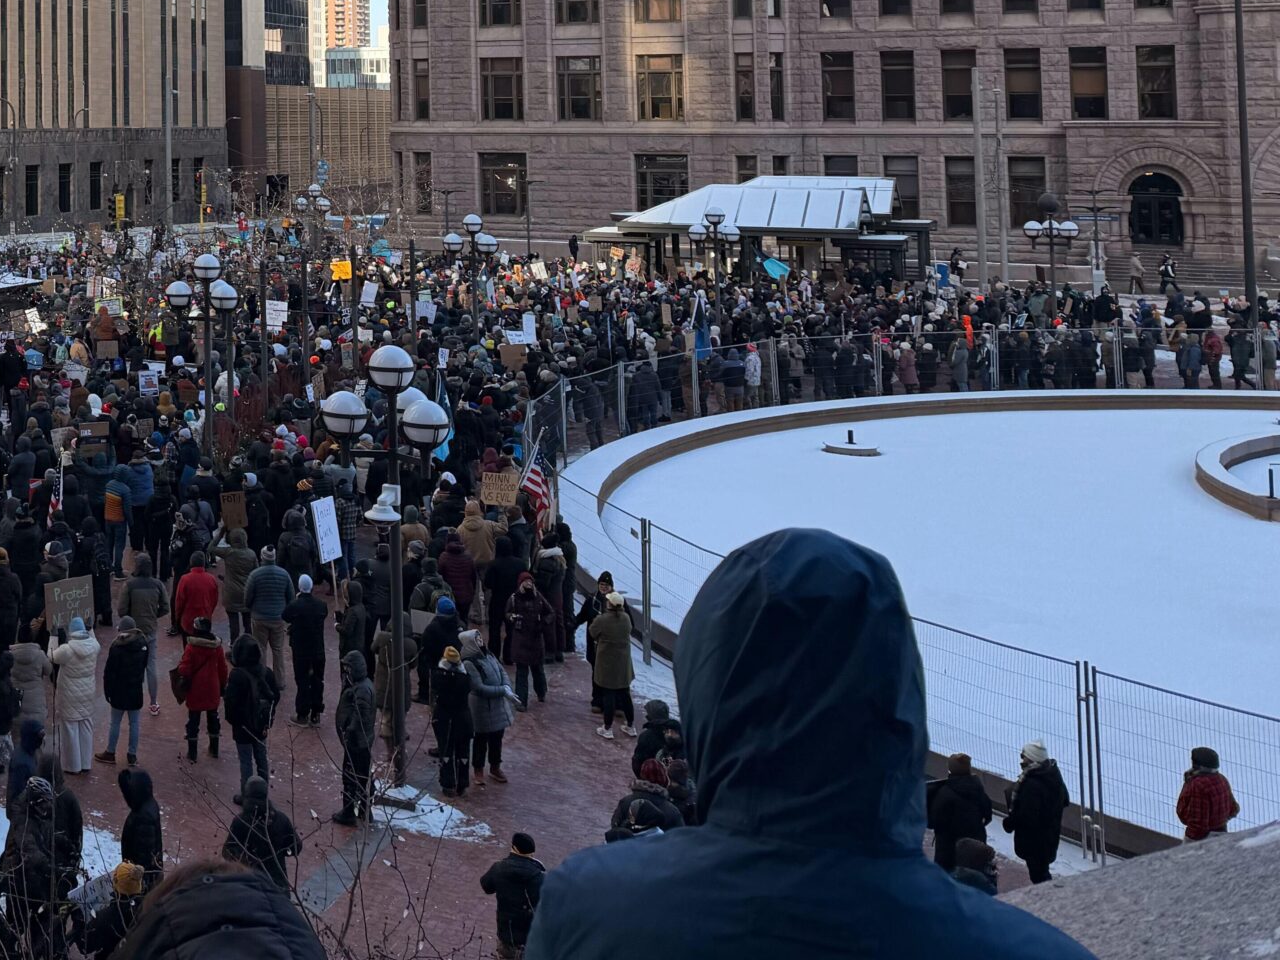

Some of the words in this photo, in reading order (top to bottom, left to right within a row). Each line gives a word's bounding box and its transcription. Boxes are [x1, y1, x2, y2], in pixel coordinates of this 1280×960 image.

[485, 474, 510, 482] MINN
[484, 492, 494, 501] VS
[496, 493, 512, 503] EVIL
[53, 584, 89, 602] Protect
